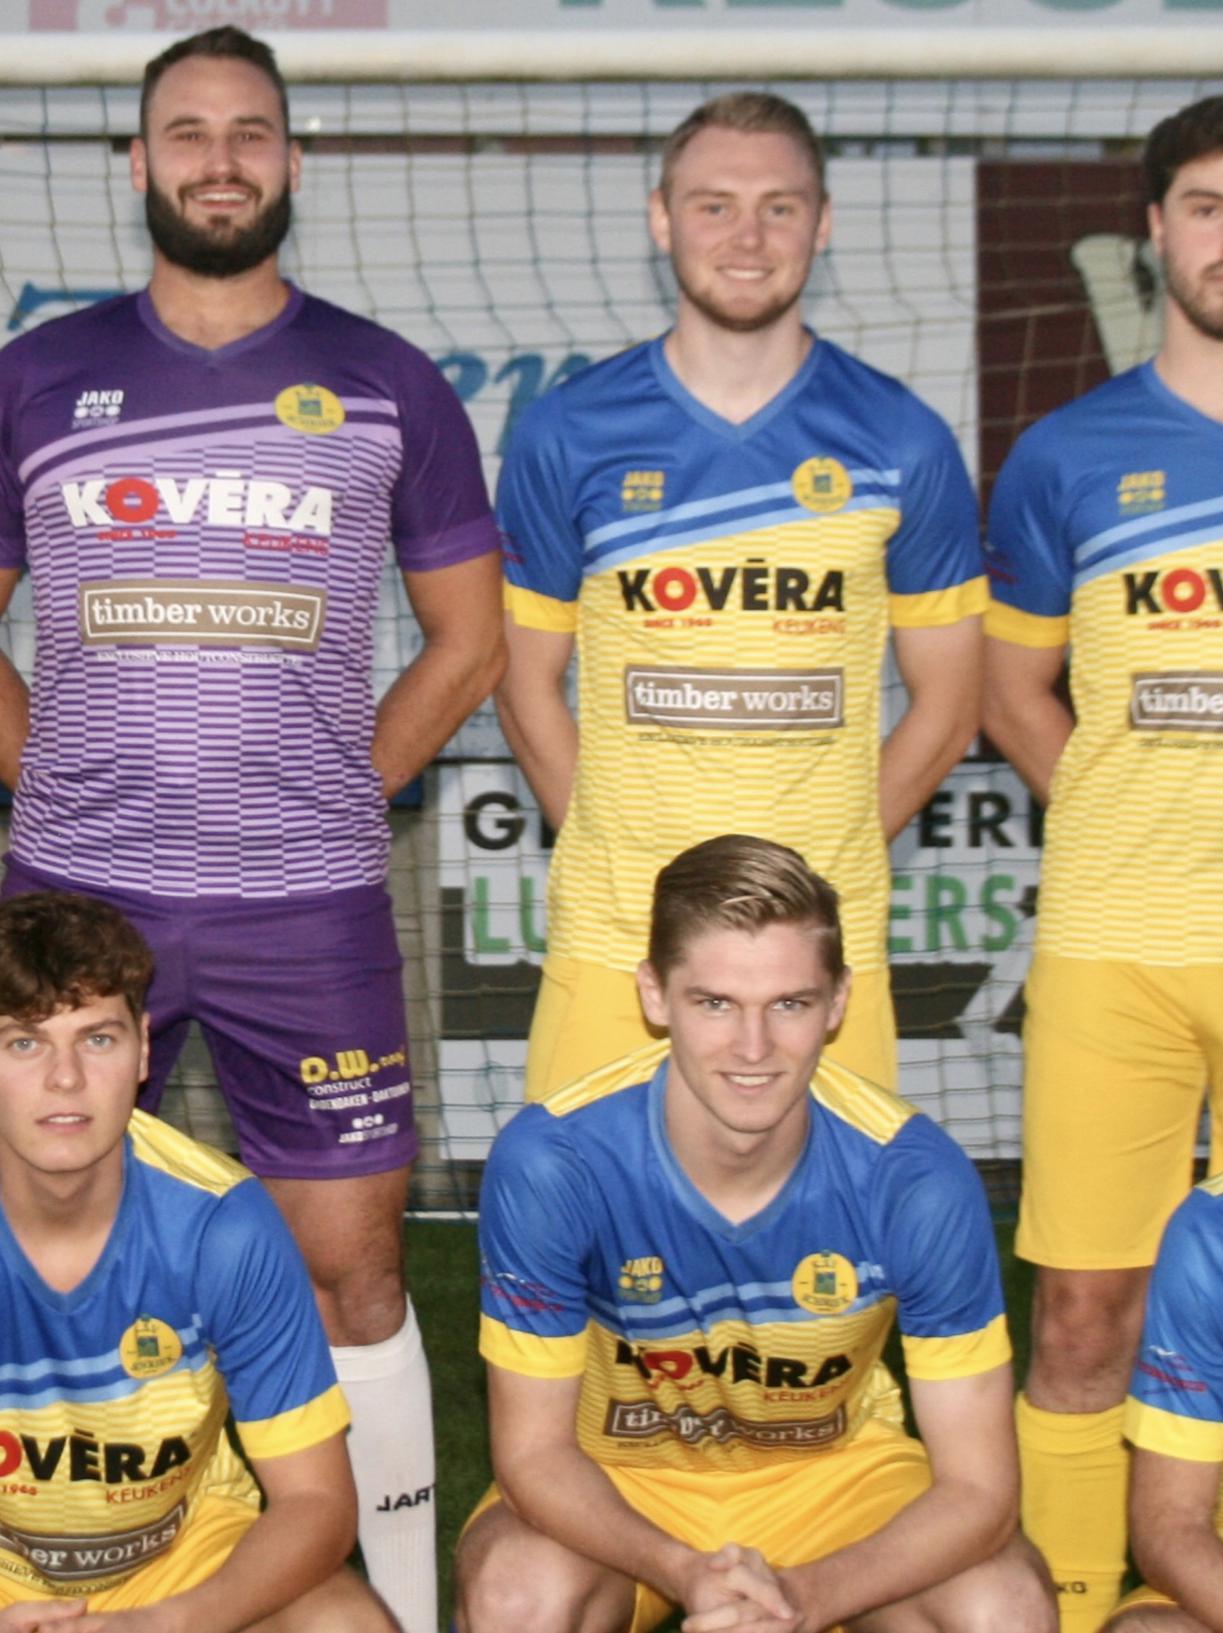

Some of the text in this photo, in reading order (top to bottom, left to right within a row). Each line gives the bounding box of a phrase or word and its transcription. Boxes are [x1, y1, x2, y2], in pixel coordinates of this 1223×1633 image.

[76, 389, 124, 406] JAKO
[91, 597, 310, 630] timber works
[634, 682, 834, 711] timber works
[74, 1524, 177, 1567] works
